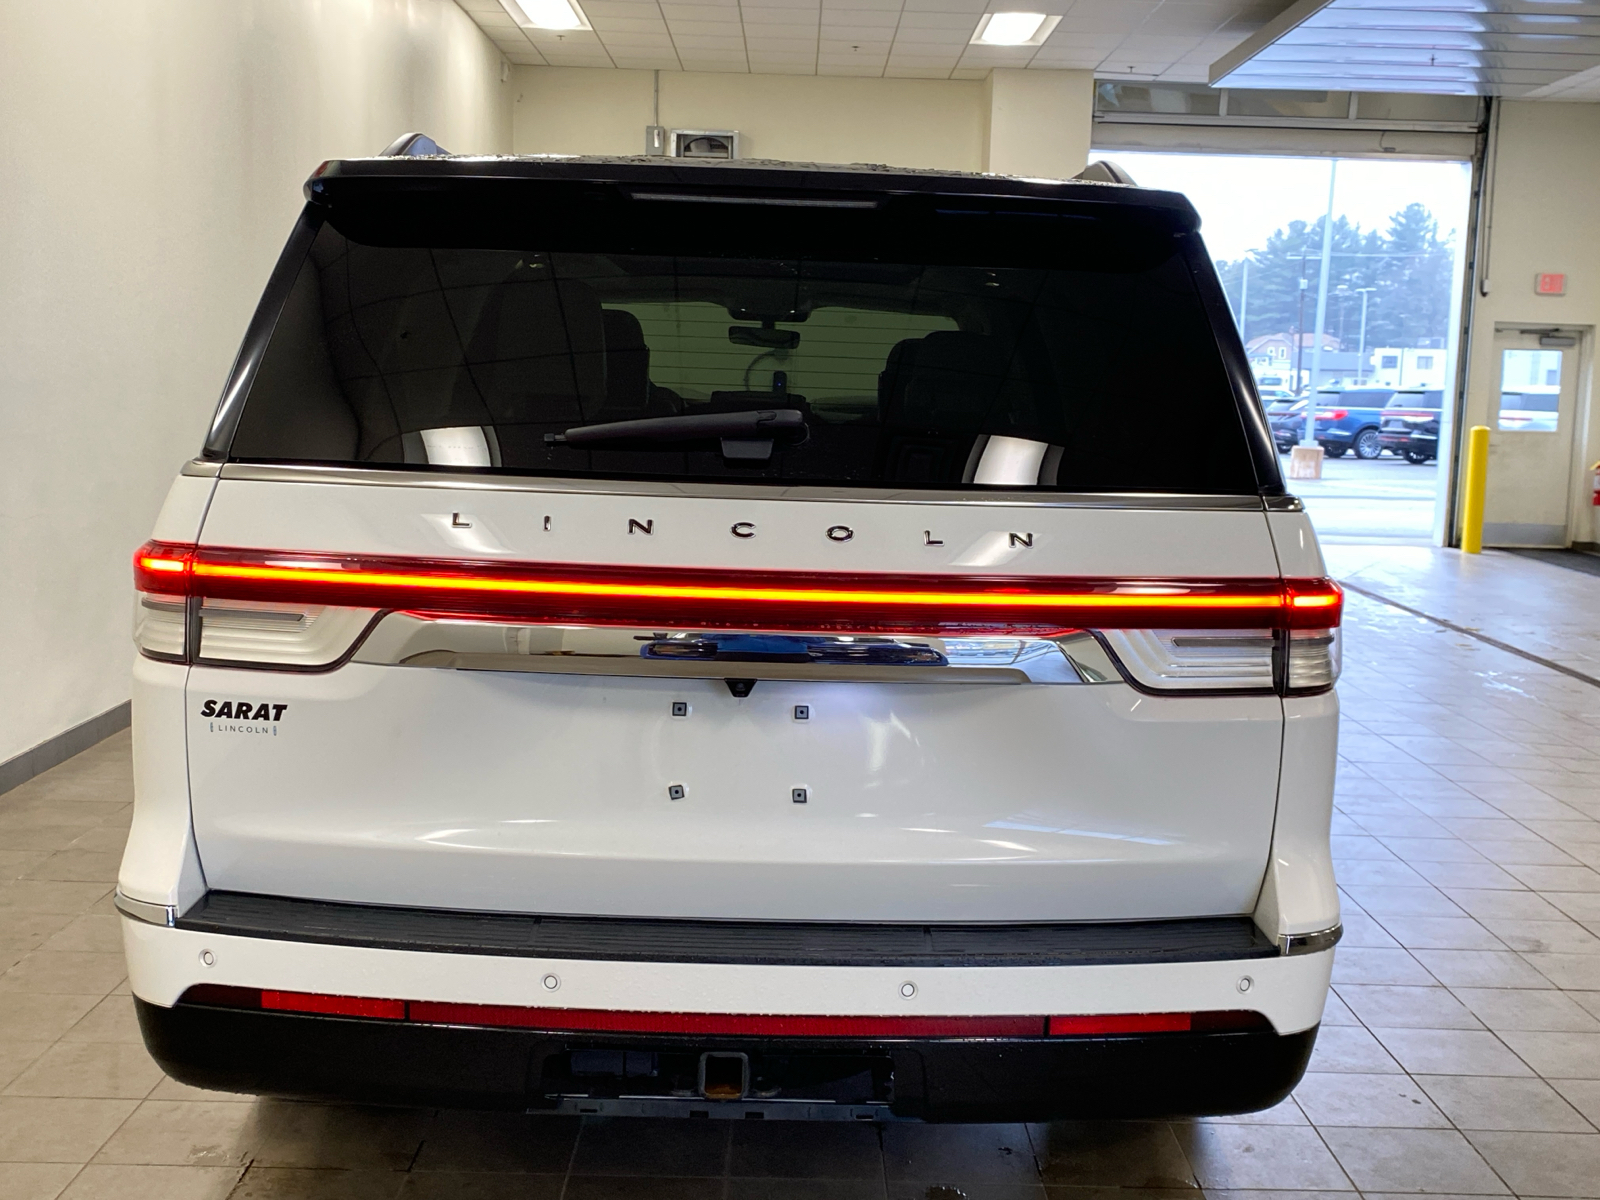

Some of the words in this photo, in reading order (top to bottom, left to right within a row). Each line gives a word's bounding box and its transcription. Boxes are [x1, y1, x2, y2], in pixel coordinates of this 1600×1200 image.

[452, 511, 1034, 549] LINCOLN
[200, 699, 289, 722] SARAT
[218, 724, 269, 735] LINCOLN
